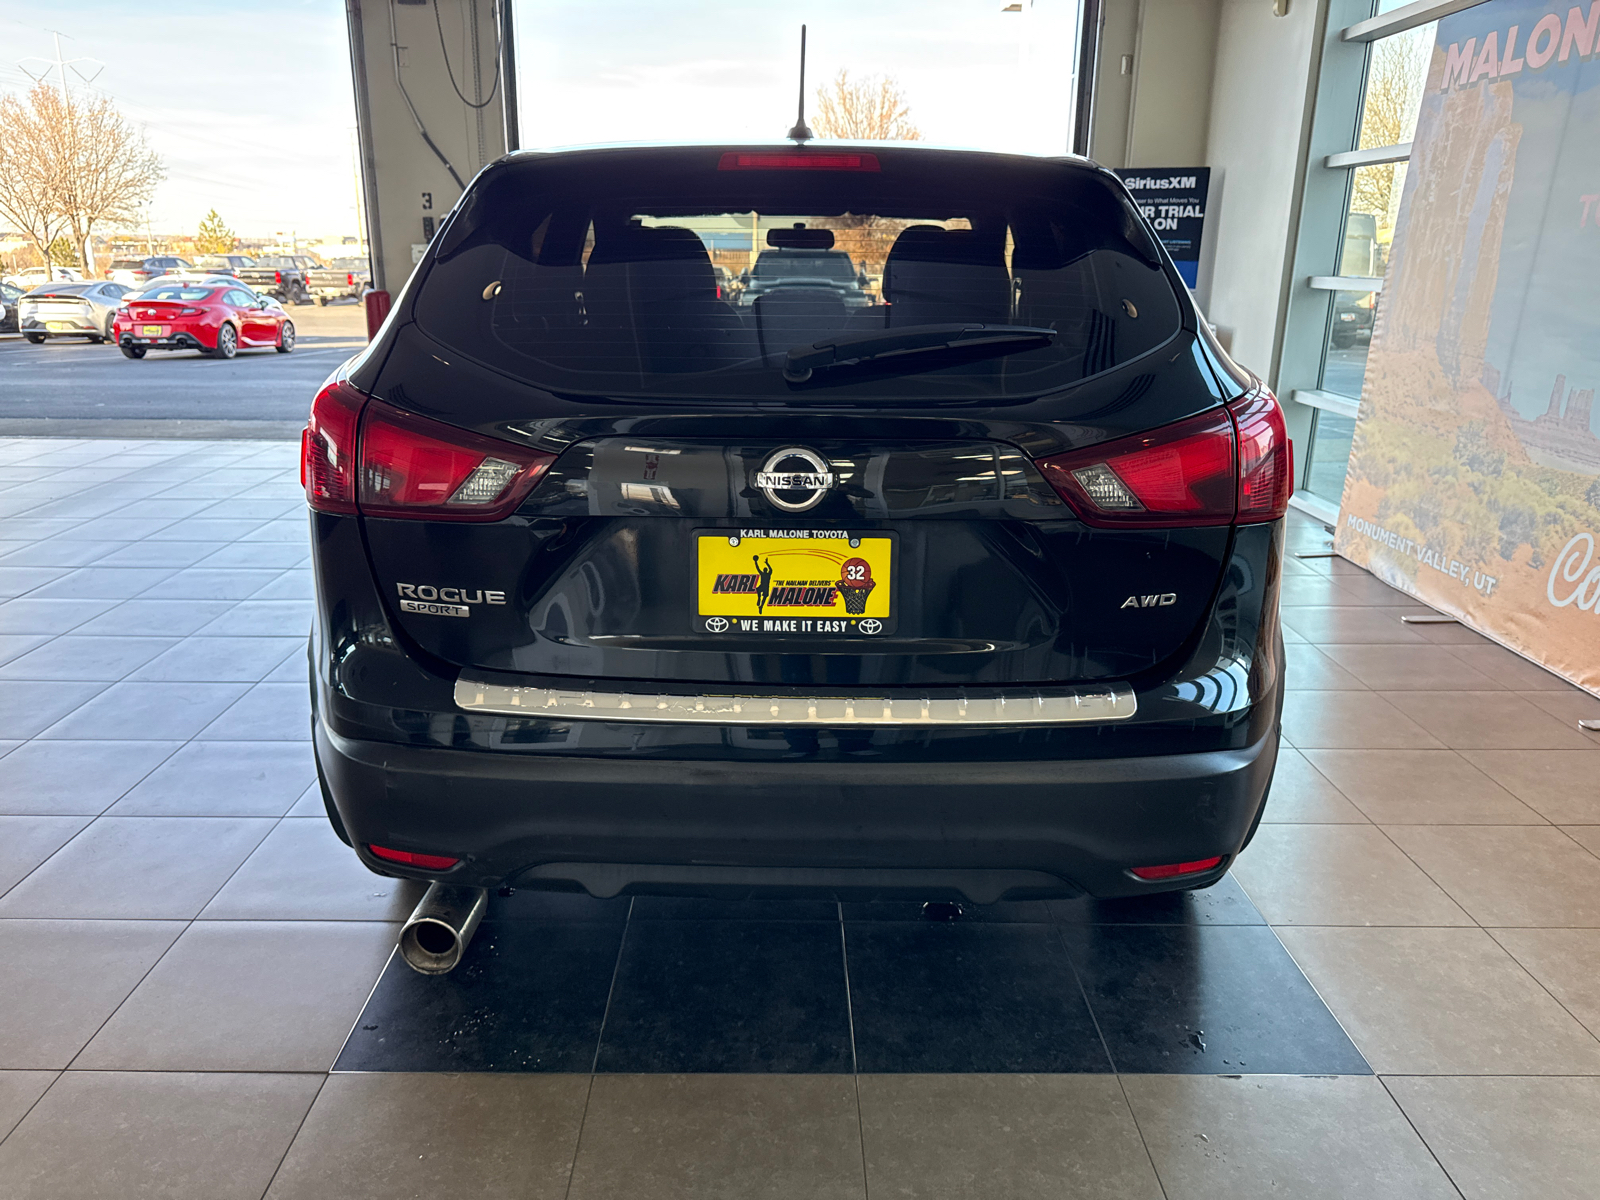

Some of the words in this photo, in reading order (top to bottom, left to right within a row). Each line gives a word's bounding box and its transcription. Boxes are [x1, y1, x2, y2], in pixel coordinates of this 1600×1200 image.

[1441, 0, 1600, 89] MALON
[1124, 177, 1197, 189] SiriusXM
[422, 192, 432, 209] 3
[1158, 205, 1204, 218] TRIAL
[1154, 218, 1178, 230] ON
[766, 476, 825, 486] NISSAN
[740, 529, 766, 538] KARL
[769, 530, 809, 538] MALONE
[812, 530, 849, 539] TOYOTA
[1347, 514, 1414, 555] MONUMENT
[1417, 544, 1470, 586] VALLEY,
[1474, 571, 1496, 594] UT
[847, 565, 865, 580] 32
[712, 574, 759, 594] KARL
[396, 582, 507, 605] ROGUE
[767, 587, 838, 606] MALONE
[1120, 593, 1177, 608] AWD
[406, 602, 463, 615] SPORT
[741, 619, 759, 632] WE
[763, 620, 796, 632] MAKE
[802, 620, 812, 632] IT
[816, 620, 847, 632] EASY
